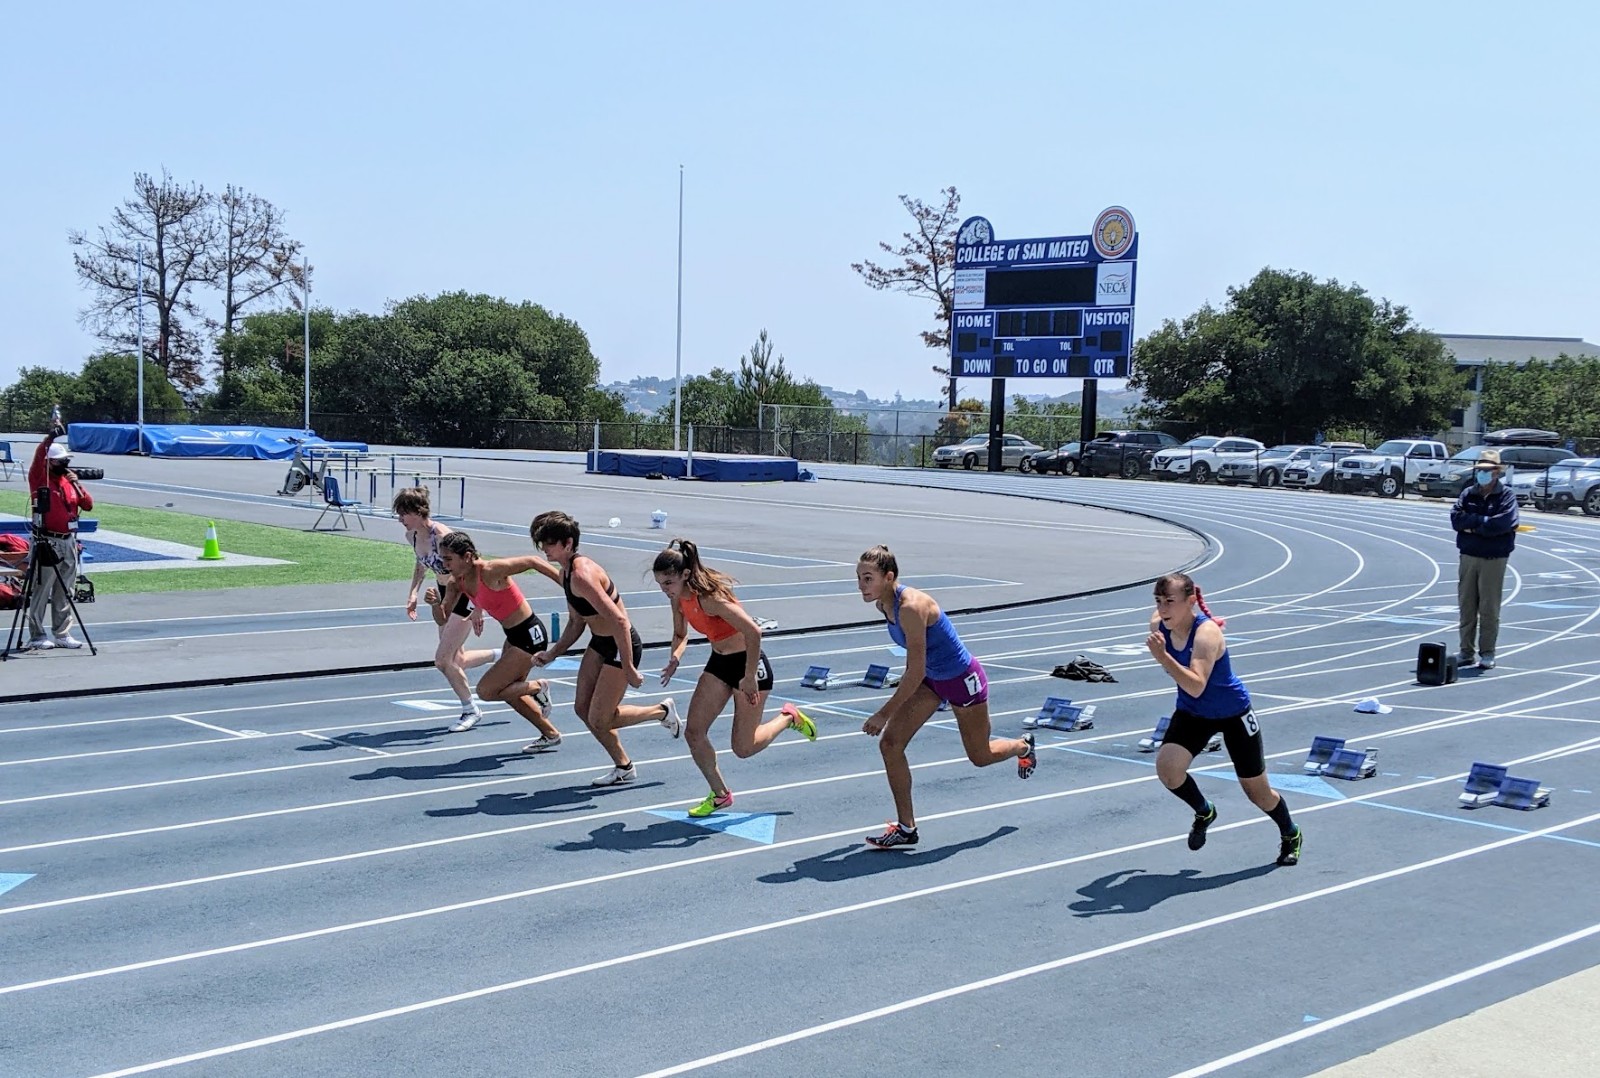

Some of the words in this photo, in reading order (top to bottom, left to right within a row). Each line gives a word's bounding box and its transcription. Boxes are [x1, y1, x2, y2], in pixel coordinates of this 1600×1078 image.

[957, 245, 1005, 263] COLLEGE
[1007, 244, 1020, 260] of
[1022, 243, 1045, 260] SAN
[1048, 240, 1089, 259] MATEO
[1098, 282, 1127, 294] NECA
[957, 315, 991, 328] HOME
[1085, 312, 1130, 325] VISITOR
[1003, 342, 1014, 351] TOL
[1060, 342, 1071, 351] TOL
[963, 359, 991, 374] DOWN
[1016, 359, 1030, 373] TO
[1033, 359, 1047, 373] GO
[1053, 359, 1068, 374] ON
[1094, 359, 1115, 374] QTR
[533, 626, 542, 642] 4
[967, 675, 978, 692] 7
[1246, 713, 1258, 733] 8
